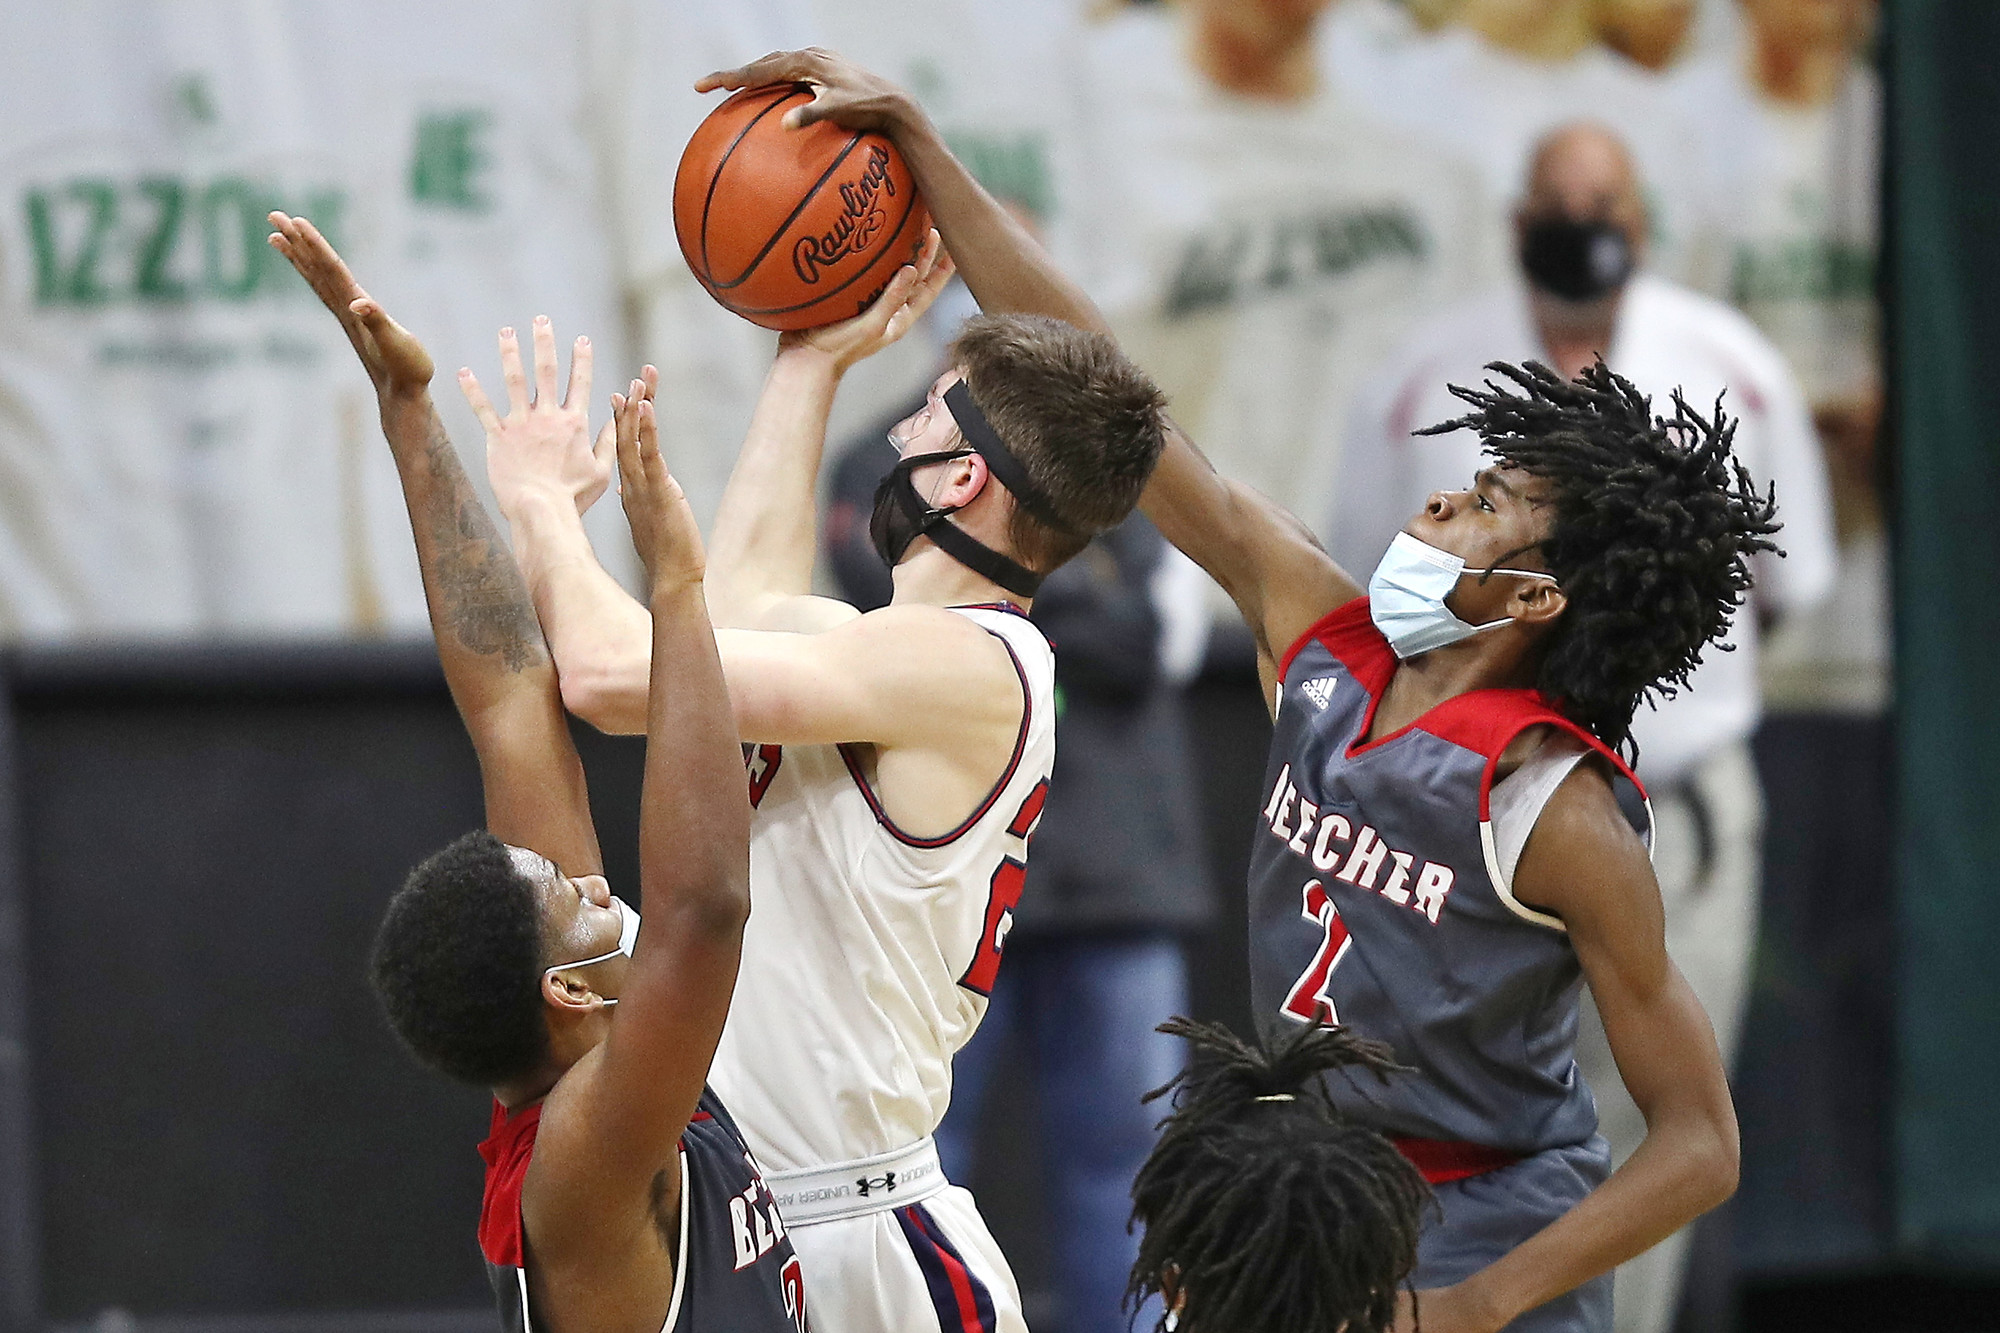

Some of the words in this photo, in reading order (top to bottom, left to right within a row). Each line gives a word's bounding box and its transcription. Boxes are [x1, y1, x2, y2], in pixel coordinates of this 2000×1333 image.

[793, 145, 896, 284] Rawlings
[1301, 680, 1329, 710] adidas
[1279, 877, 1354, 1033] 2
